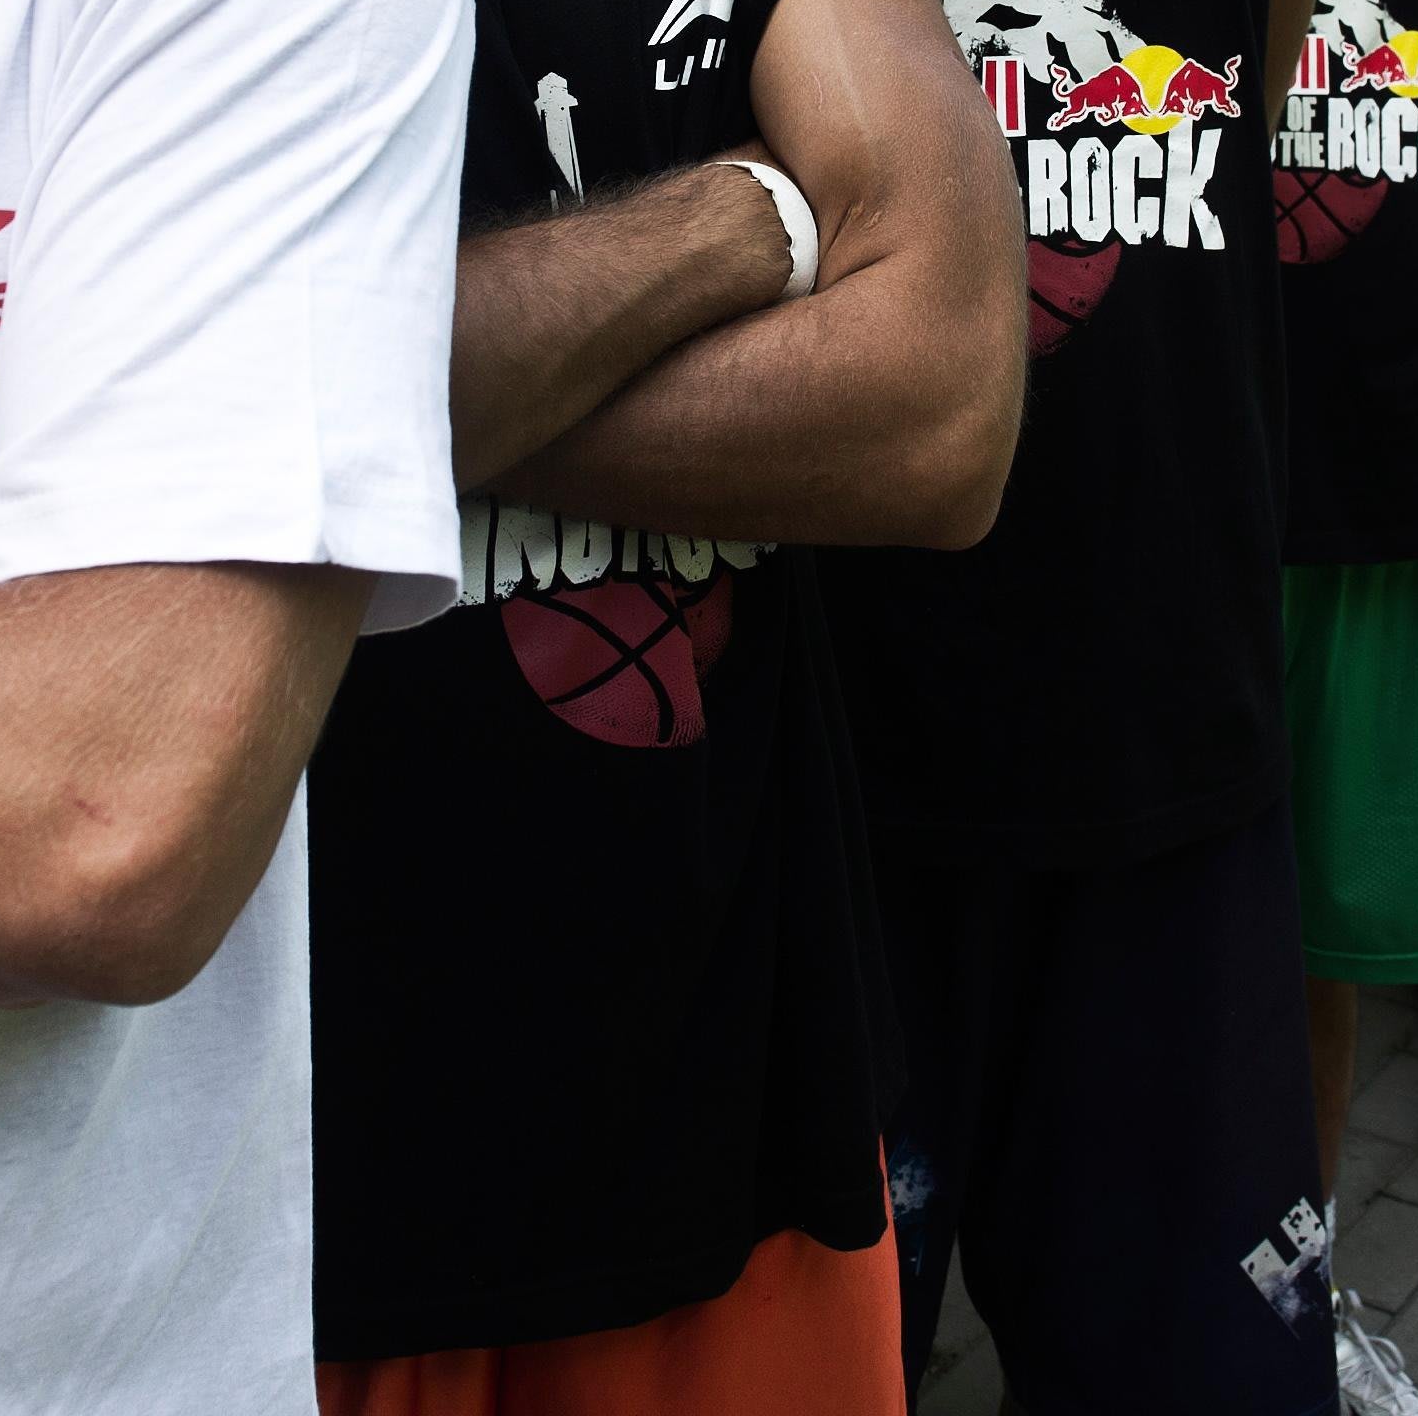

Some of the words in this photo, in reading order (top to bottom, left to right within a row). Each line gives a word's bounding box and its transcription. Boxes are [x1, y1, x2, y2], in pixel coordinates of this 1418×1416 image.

[1287, 96, 1318, 132] OF
[1279, 132, 1326, 168] THE
[1027, 118, 1226, 250] ROCK
